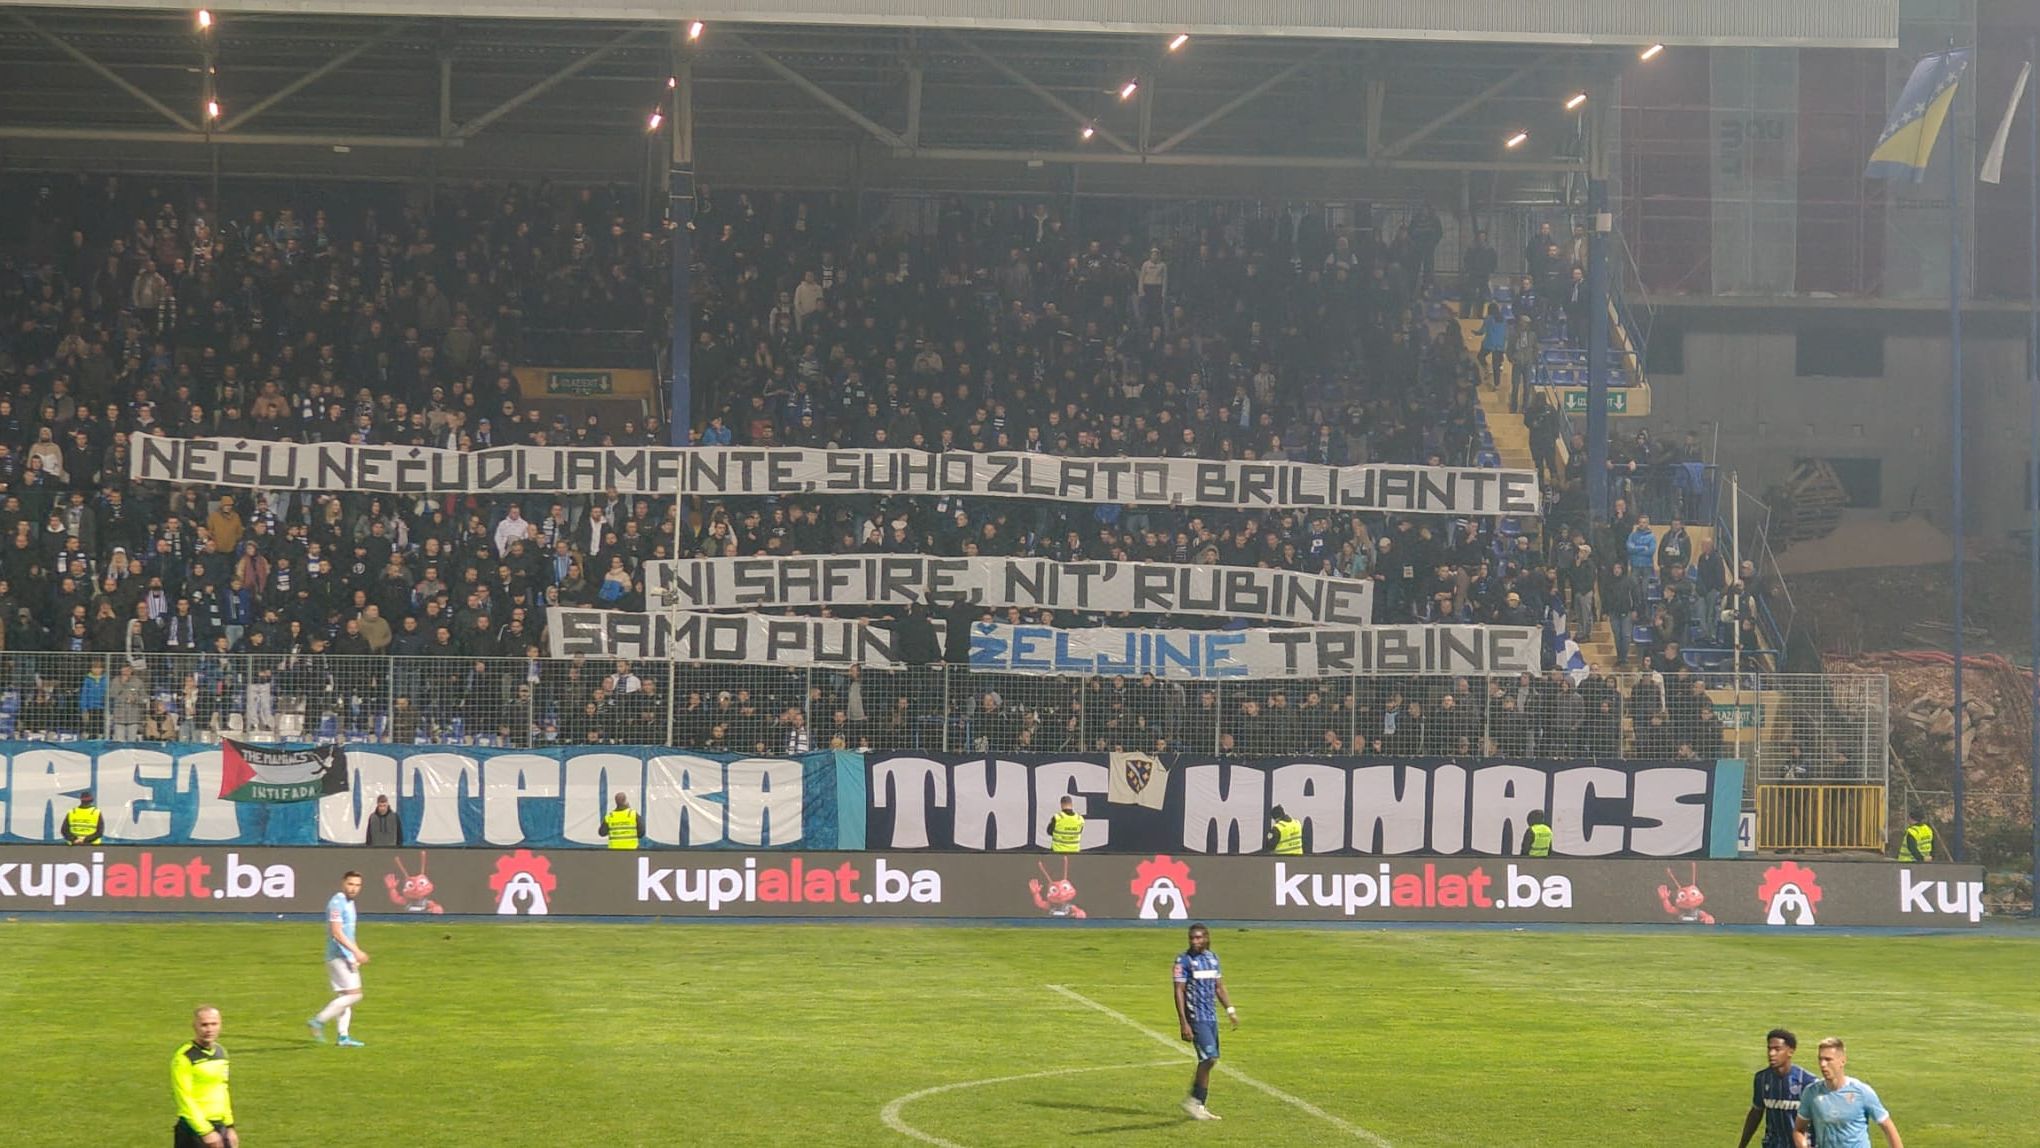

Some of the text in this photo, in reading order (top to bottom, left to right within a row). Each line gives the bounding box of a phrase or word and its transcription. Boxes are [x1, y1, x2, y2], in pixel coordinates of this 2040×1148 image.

[826, 452, 973, 491] SUHO
[1196, 463, 1534, 511] BRILIJANTE
[659, 561, 715, 606] NI
[1134, 564, 1363, 624] RUBINE
[561, 612, 747, 660] SAMO
[969, 622, 1248, 677] ŽELJINE
[1269, 629, 1528, 675] TRIBINE
[241, 749, 262, 763] THE
[0, 749, 803, 847] RET OTPORA
[251, 785, 315, 799] INTIFADA
[872, 757, 1708, 855] THE MANIACS
[1737, 817, 1751, 847] 4
[637, 857, 941, 911] kupialat.ba
[1275, 862, 1572, 916] kupialat.ba
